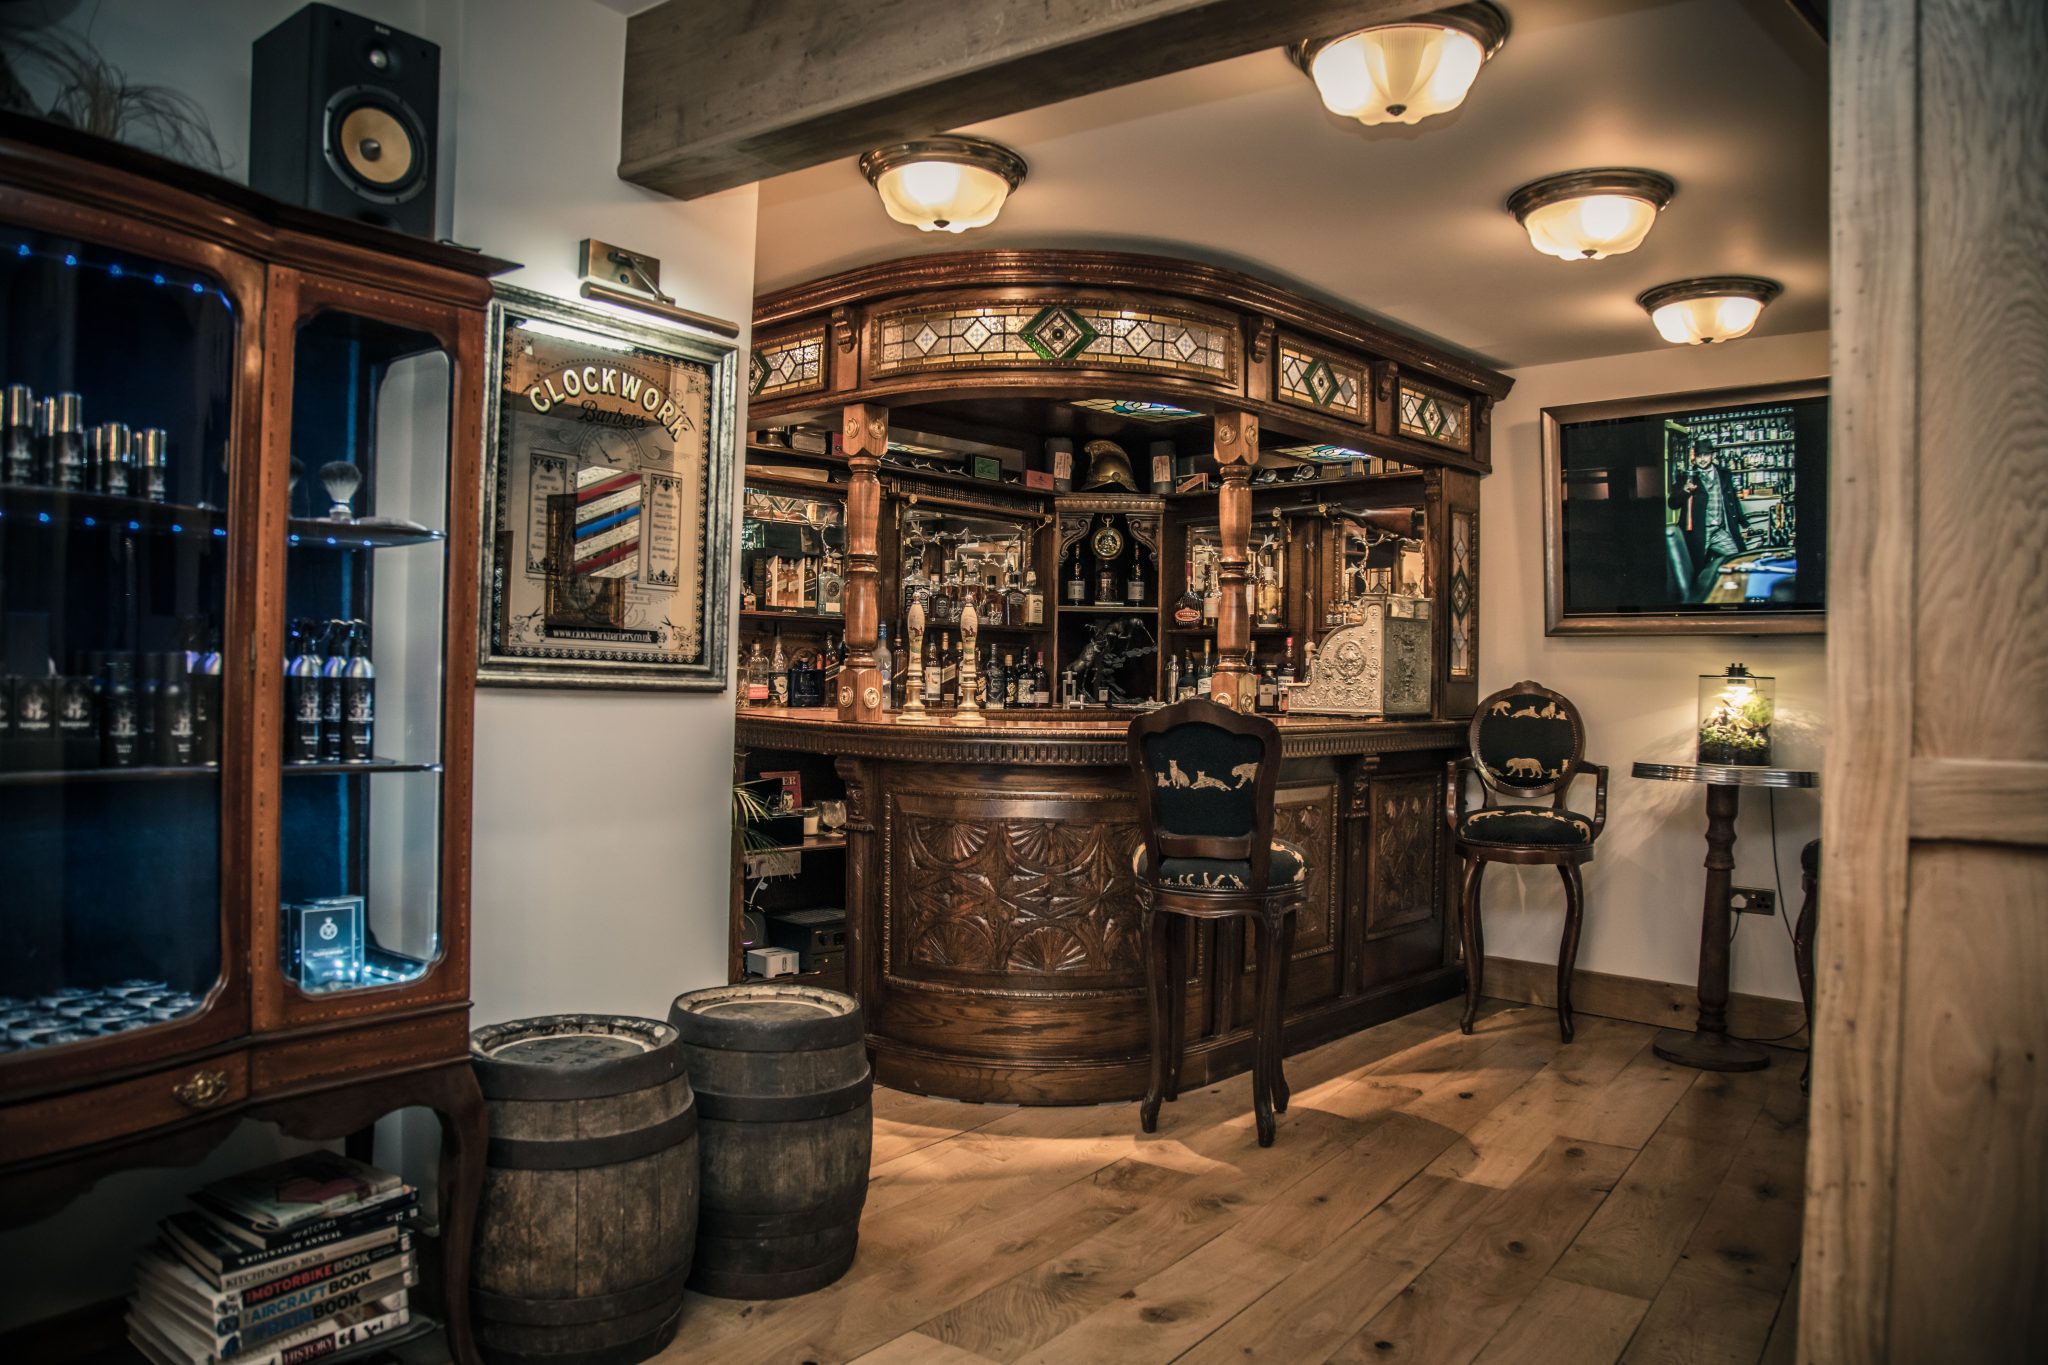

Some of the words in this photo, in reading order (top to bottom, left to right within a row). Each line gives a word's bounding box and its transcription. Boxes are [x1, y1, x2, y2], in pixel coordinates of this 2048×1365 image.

[529, 365, 693, 443] CLOCKWORK
[576, 399, 649, 430] Barbers
[552, 629, 653, 644] www.clockworkbarbers.co.uk
[250, 1263, 333, 1302] MOTORBIKE
[333, 1252, 372, 1272] BOOK
[251, 1284, 326, 1322] AIRCRAFT
[328, 1268, 372, 1294] BOOK
[313, 1291, 362, 1320] BOOK
